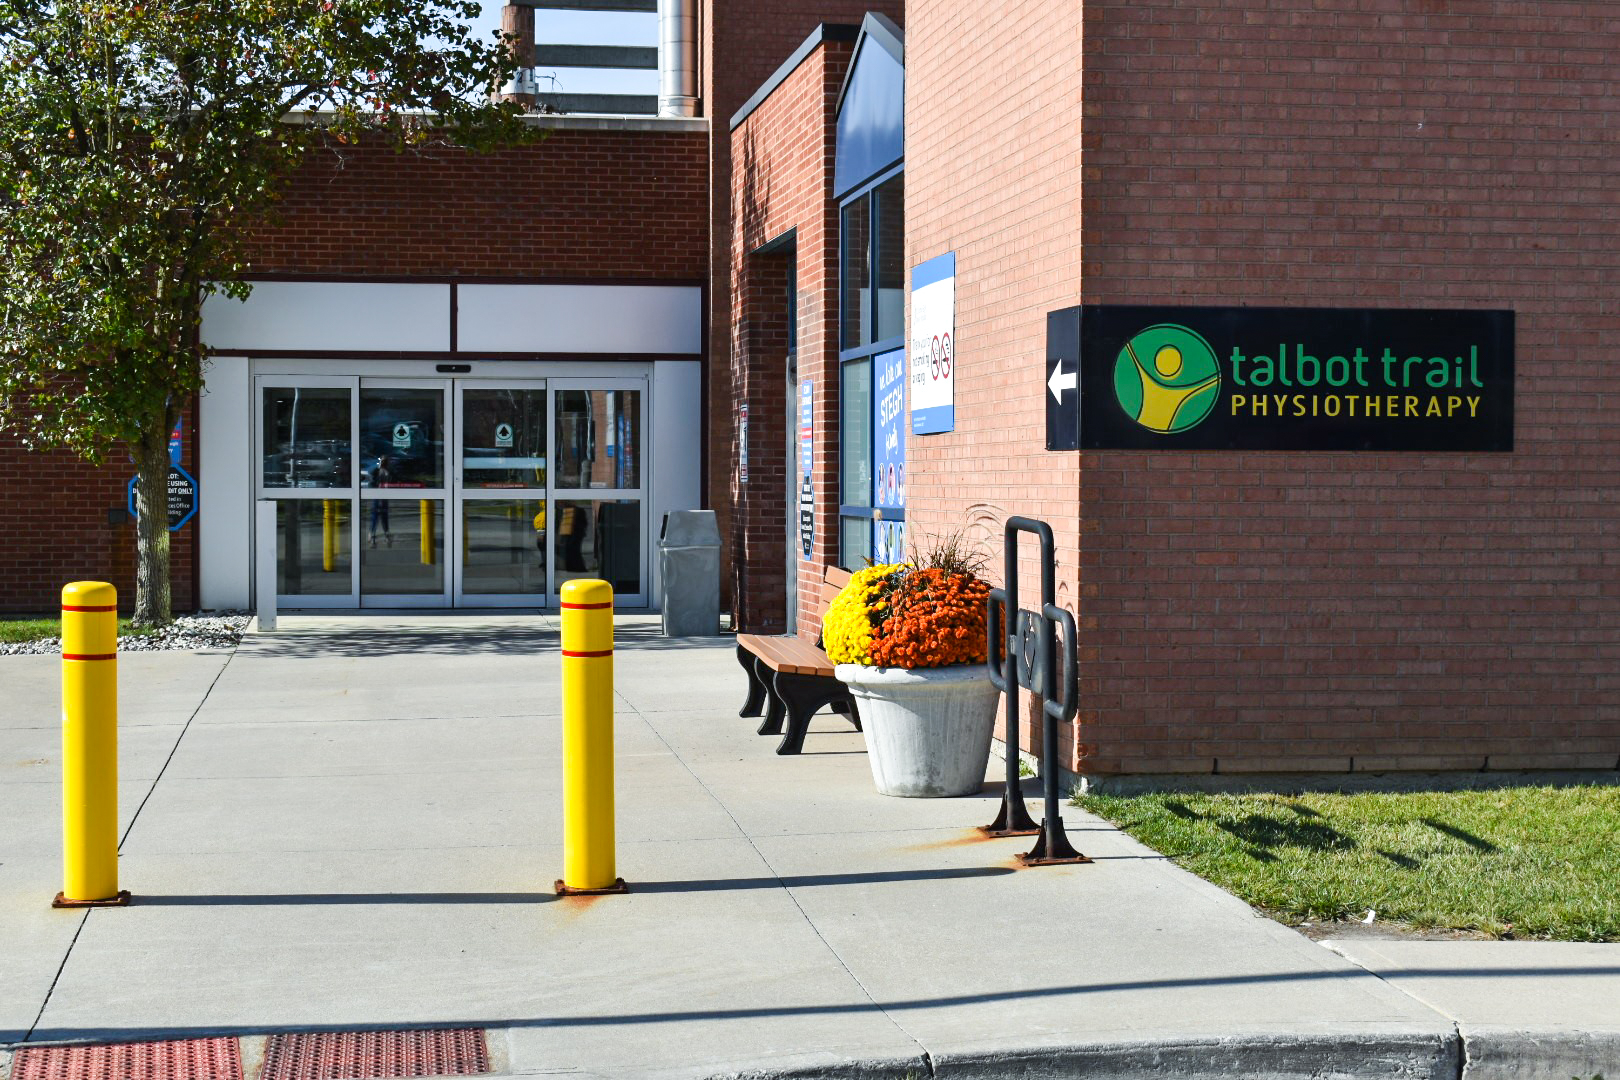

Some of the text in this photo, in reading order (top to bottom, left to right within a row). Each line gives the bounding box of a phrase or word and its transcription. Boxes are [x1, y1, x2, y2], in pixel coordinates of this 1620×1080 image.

[1230, 343, 1484, 388] talbot trail
[880, 383, 903, 427] STEGH
[1231, 394, 1481, 417] PHYSIOTHERAPY
